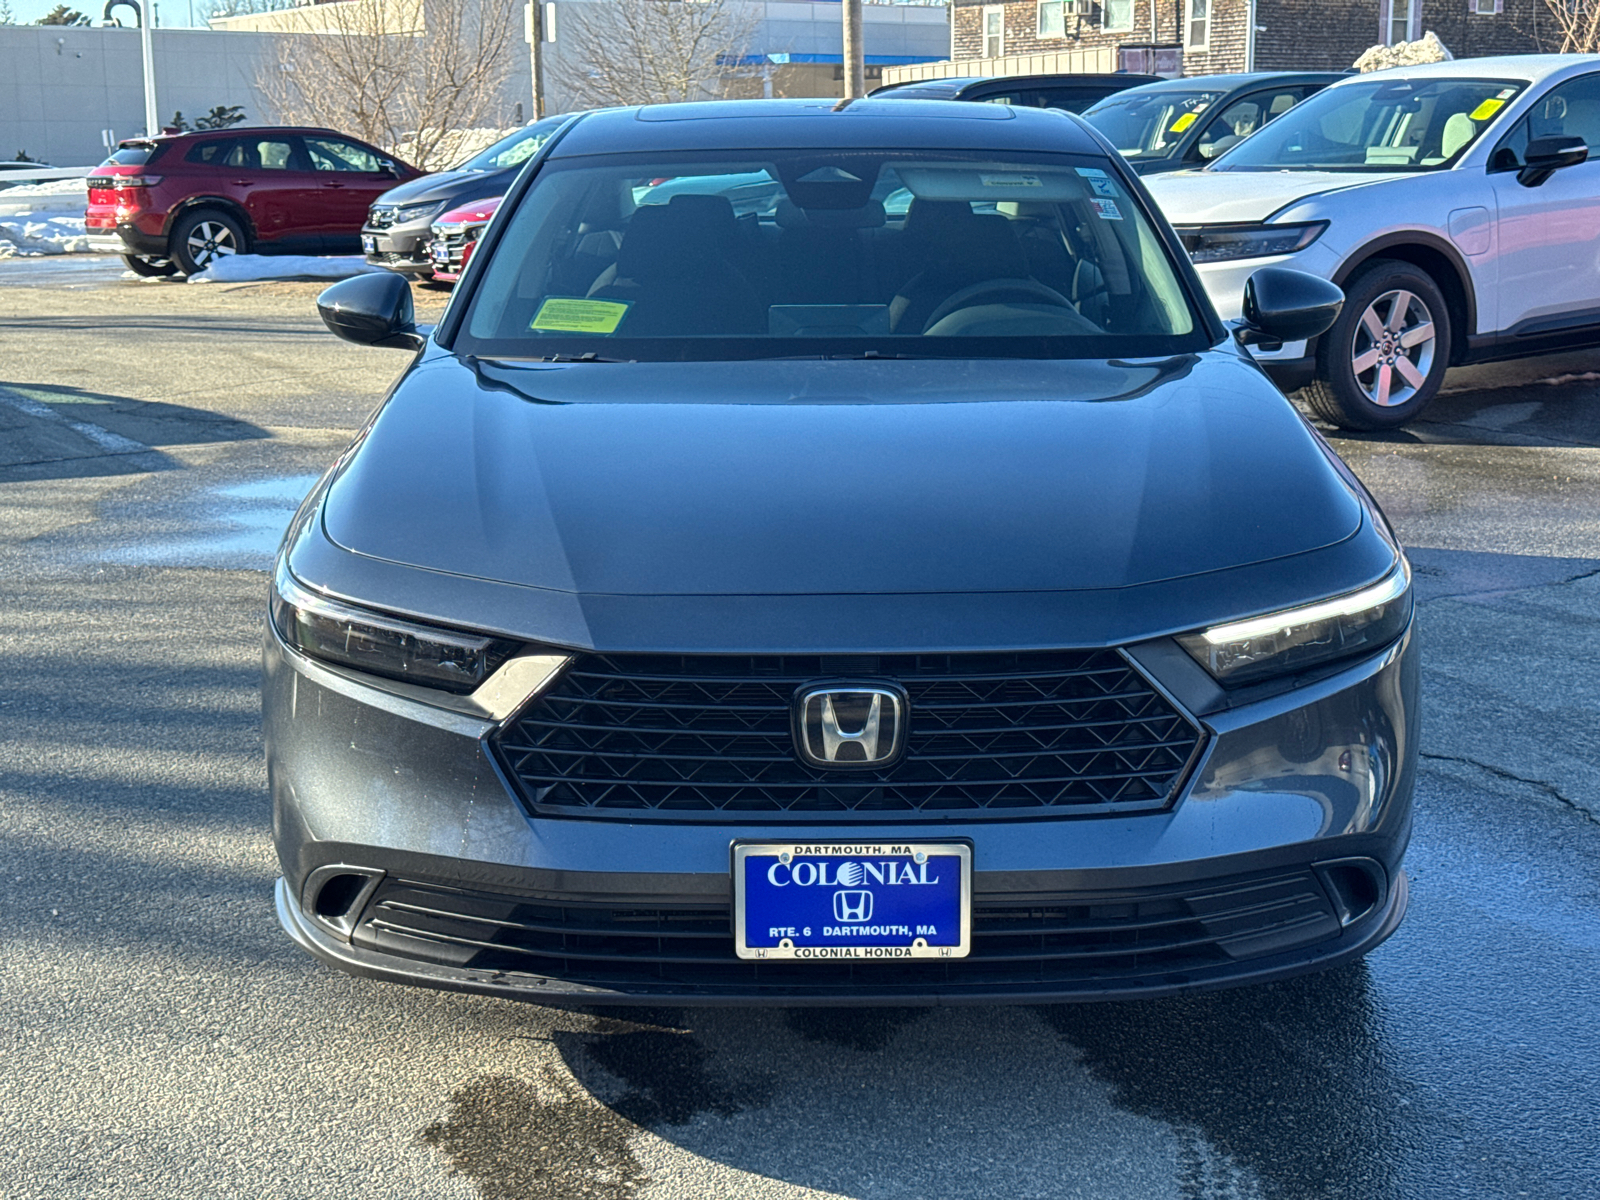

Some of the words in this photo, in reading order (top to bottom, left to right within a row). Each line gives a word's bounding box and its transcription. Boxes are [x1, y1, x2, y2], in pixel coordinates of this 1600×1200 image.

[795, 846, 886, 855] DARTMOUTH,
[891, 846, 912, 855] MA
[767, 861, 939, 886] COLONIAL
[769, 928, 800, 937] RTE.
[803, 928, 812, 937] 6
[823, 926, 913, 937] DARTMOUTH,
[916, 925, 937, 935] MA
[795, 948, 860, 957] COLONIAL
[865, 948, 912, 957] HONDA
